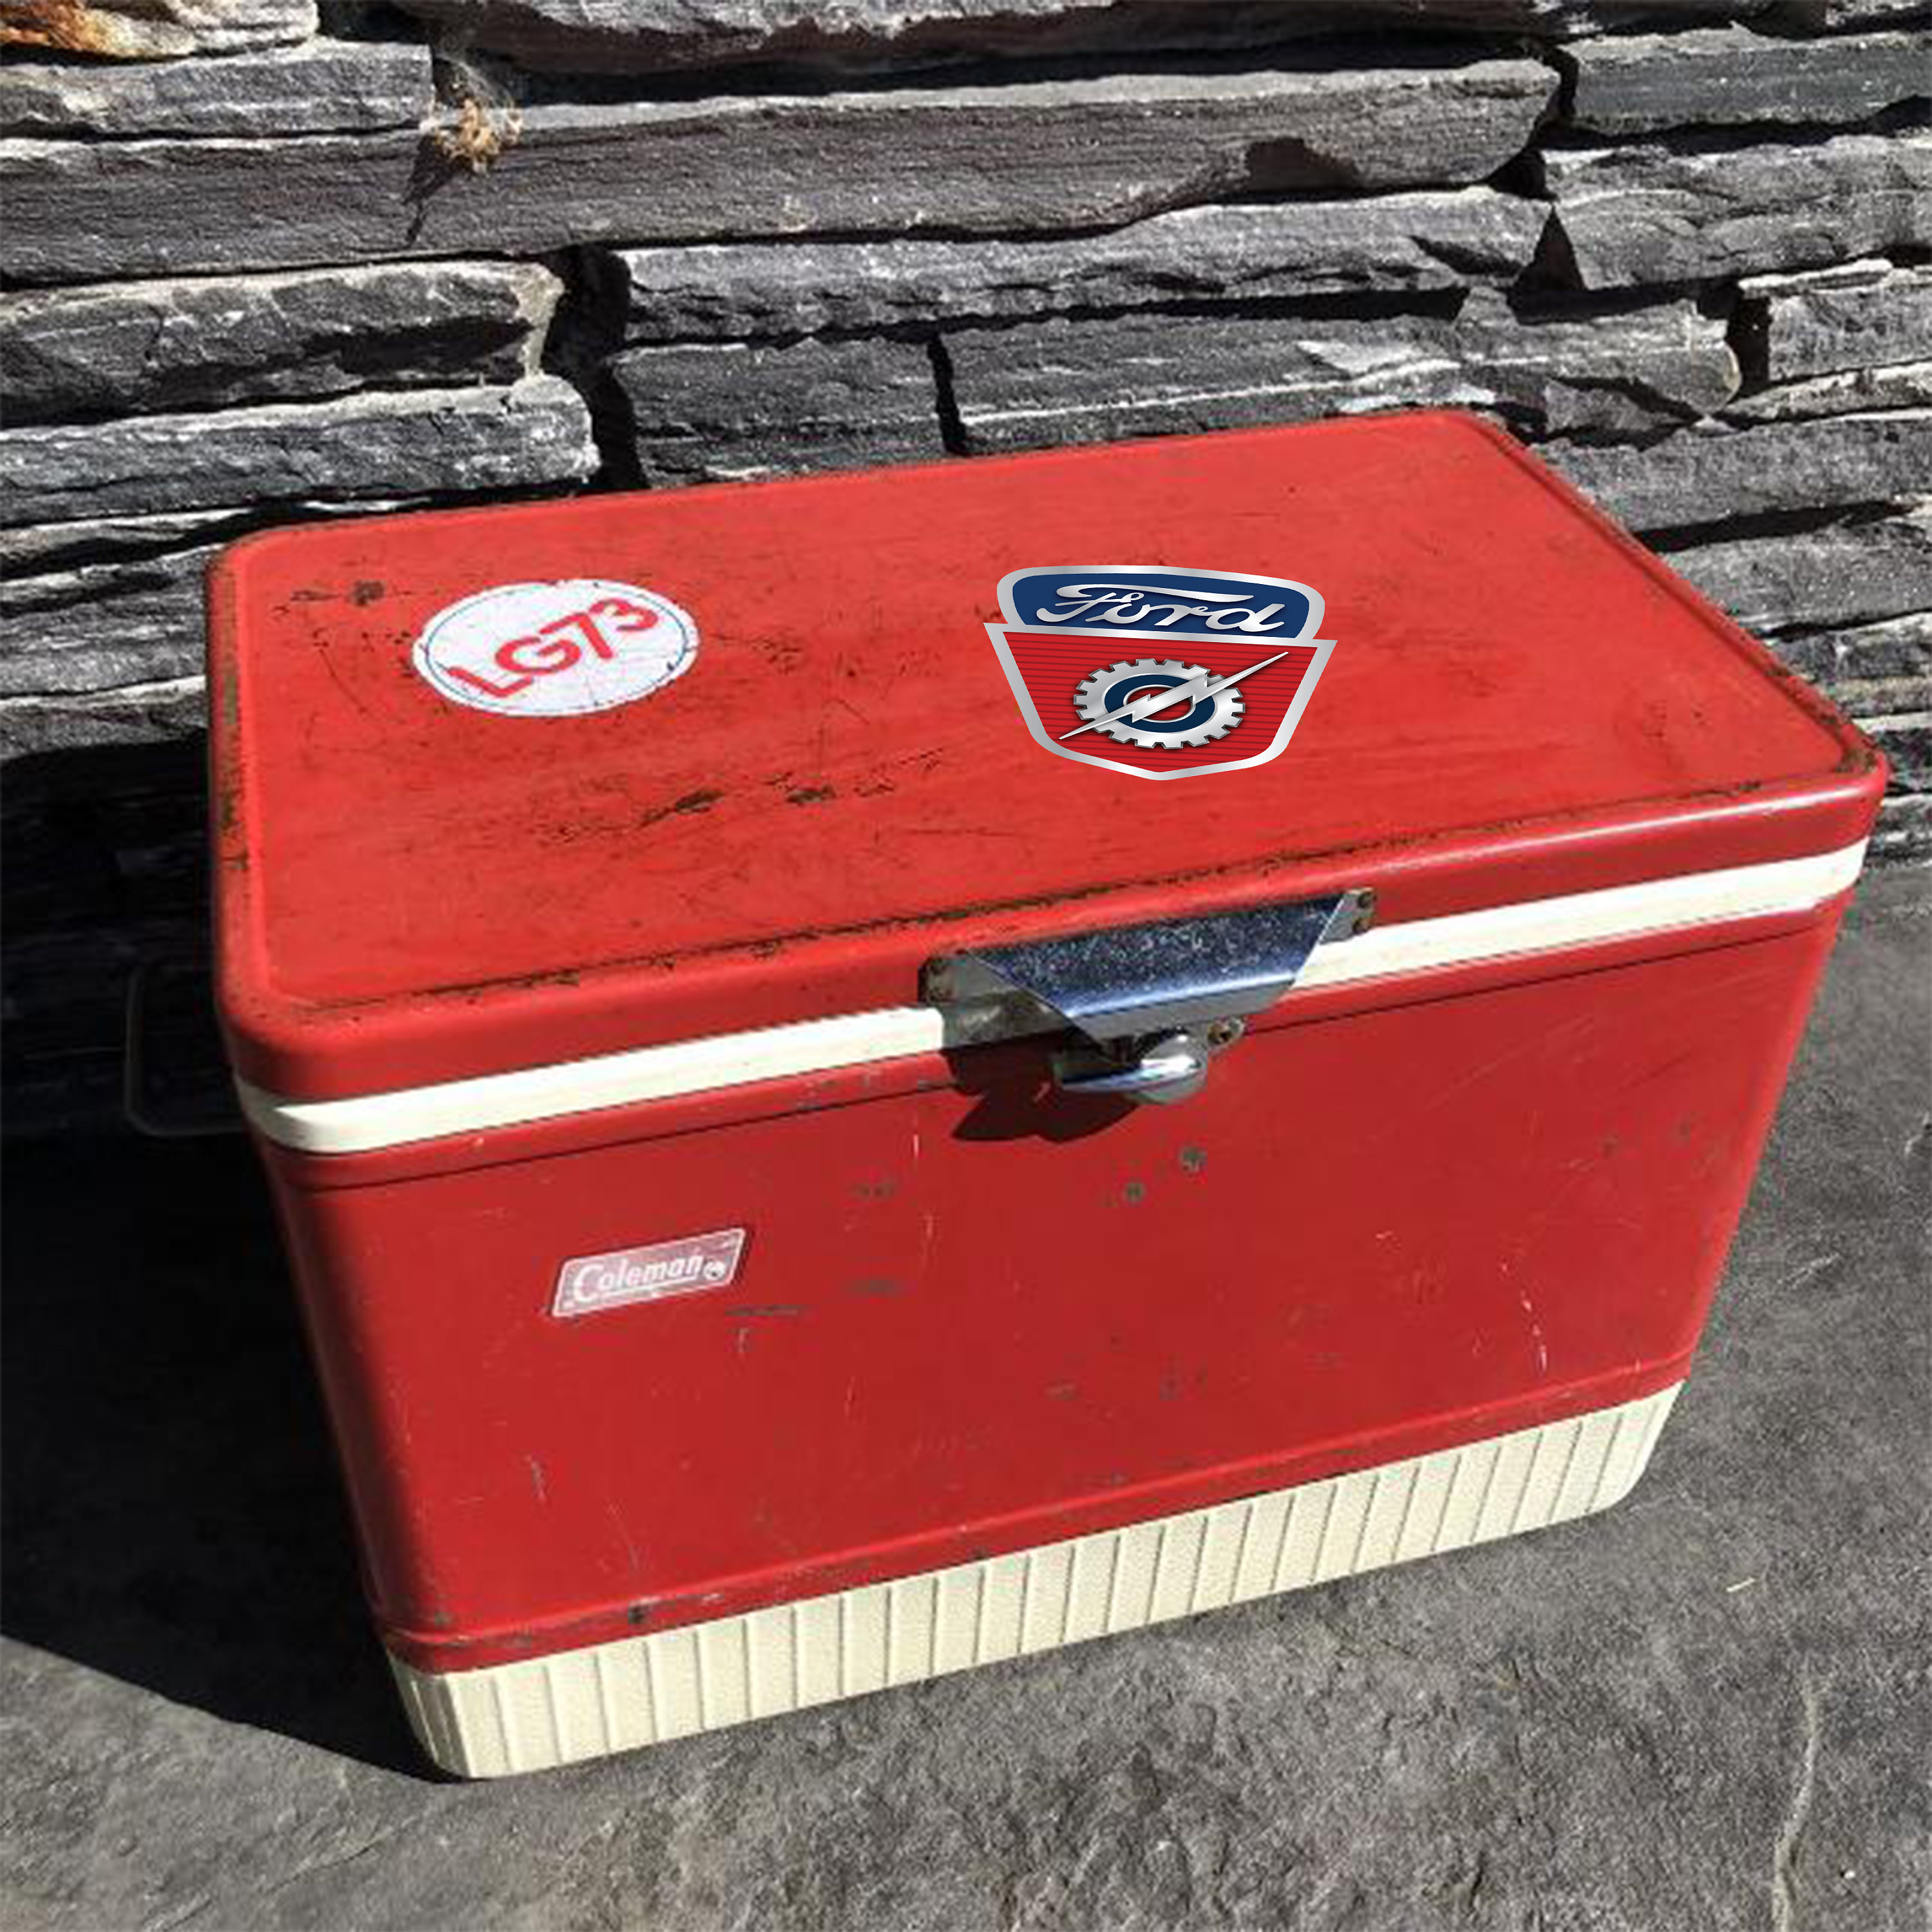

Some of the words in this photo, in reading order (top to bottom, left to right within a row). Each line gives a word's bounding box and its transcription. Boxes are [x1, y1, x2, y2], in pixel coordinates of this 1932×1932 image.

[1036, 583, 1285, 632] Ford
[446, 598, 658, 695] LG73
[573, 1255, 704, 1302] Coleman
